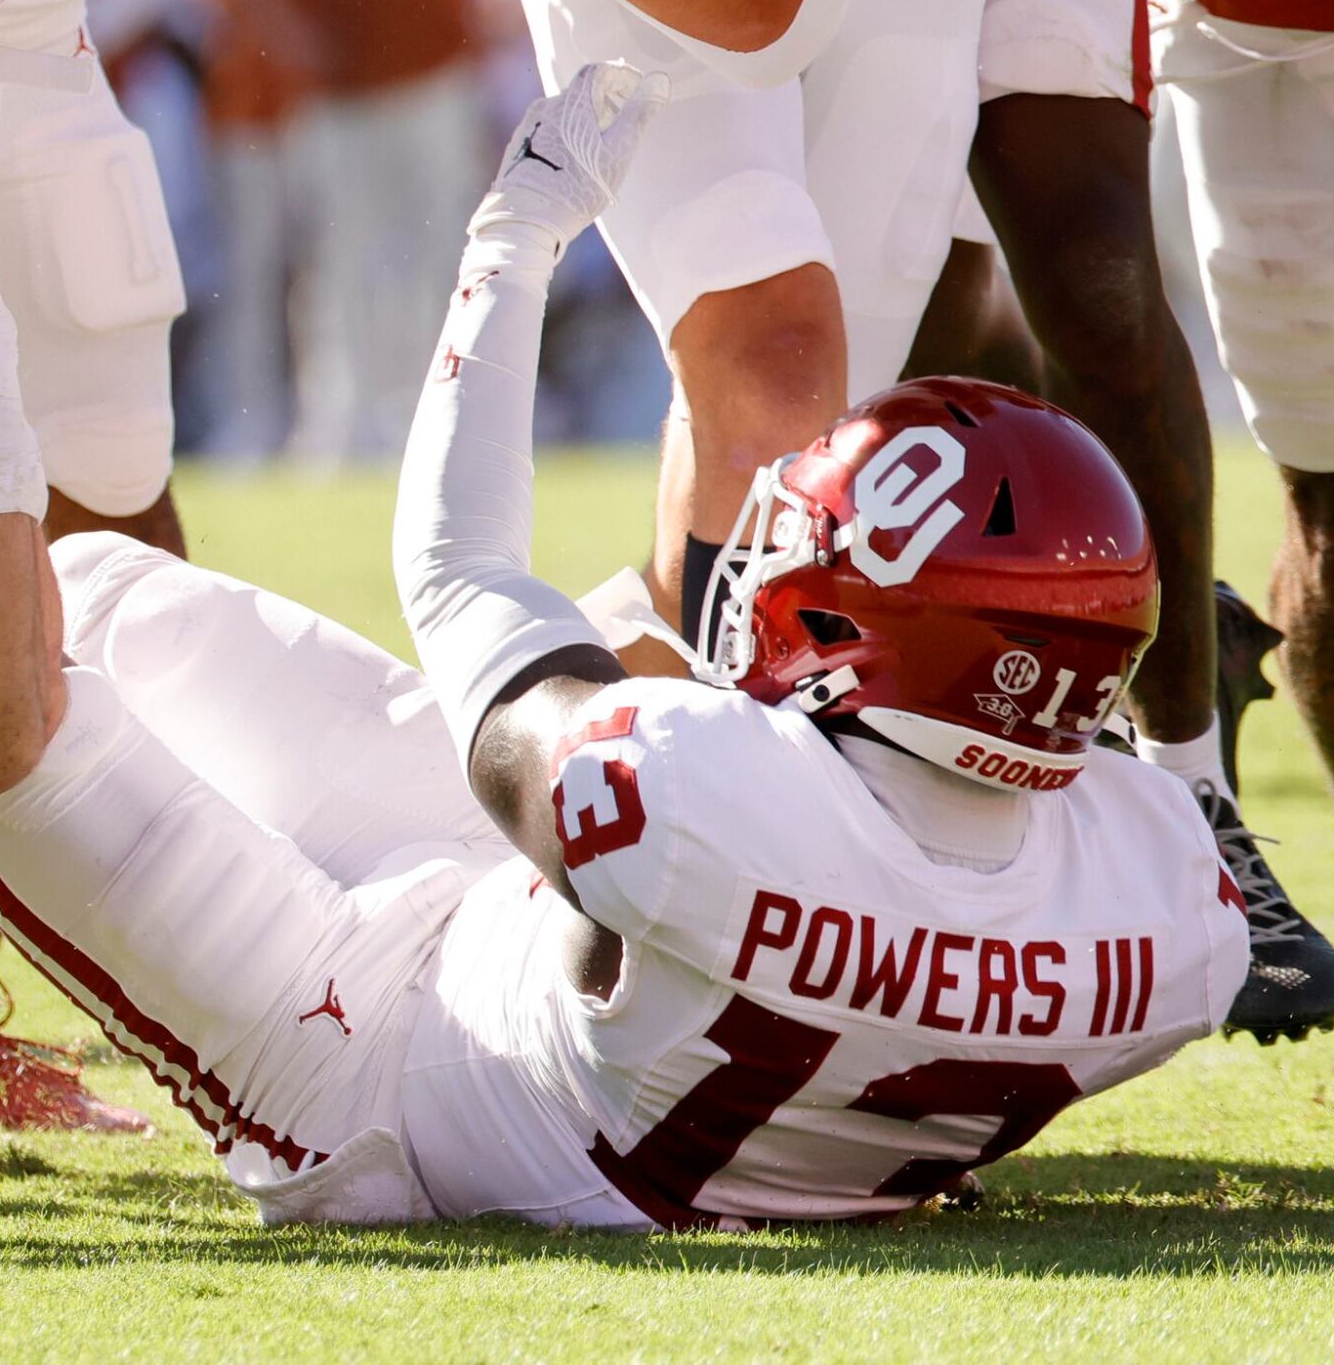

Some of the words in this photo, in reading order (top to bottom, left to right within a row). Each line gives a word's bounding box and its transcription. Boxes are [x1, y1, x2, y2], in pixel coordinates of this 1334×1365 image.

[999, 654, 1036, 690] SEC
[1031, 667, 1123, 733] 13
[732, 888, 1066, 1038] POWERS
[1089, 936, 1155, 1037] III
